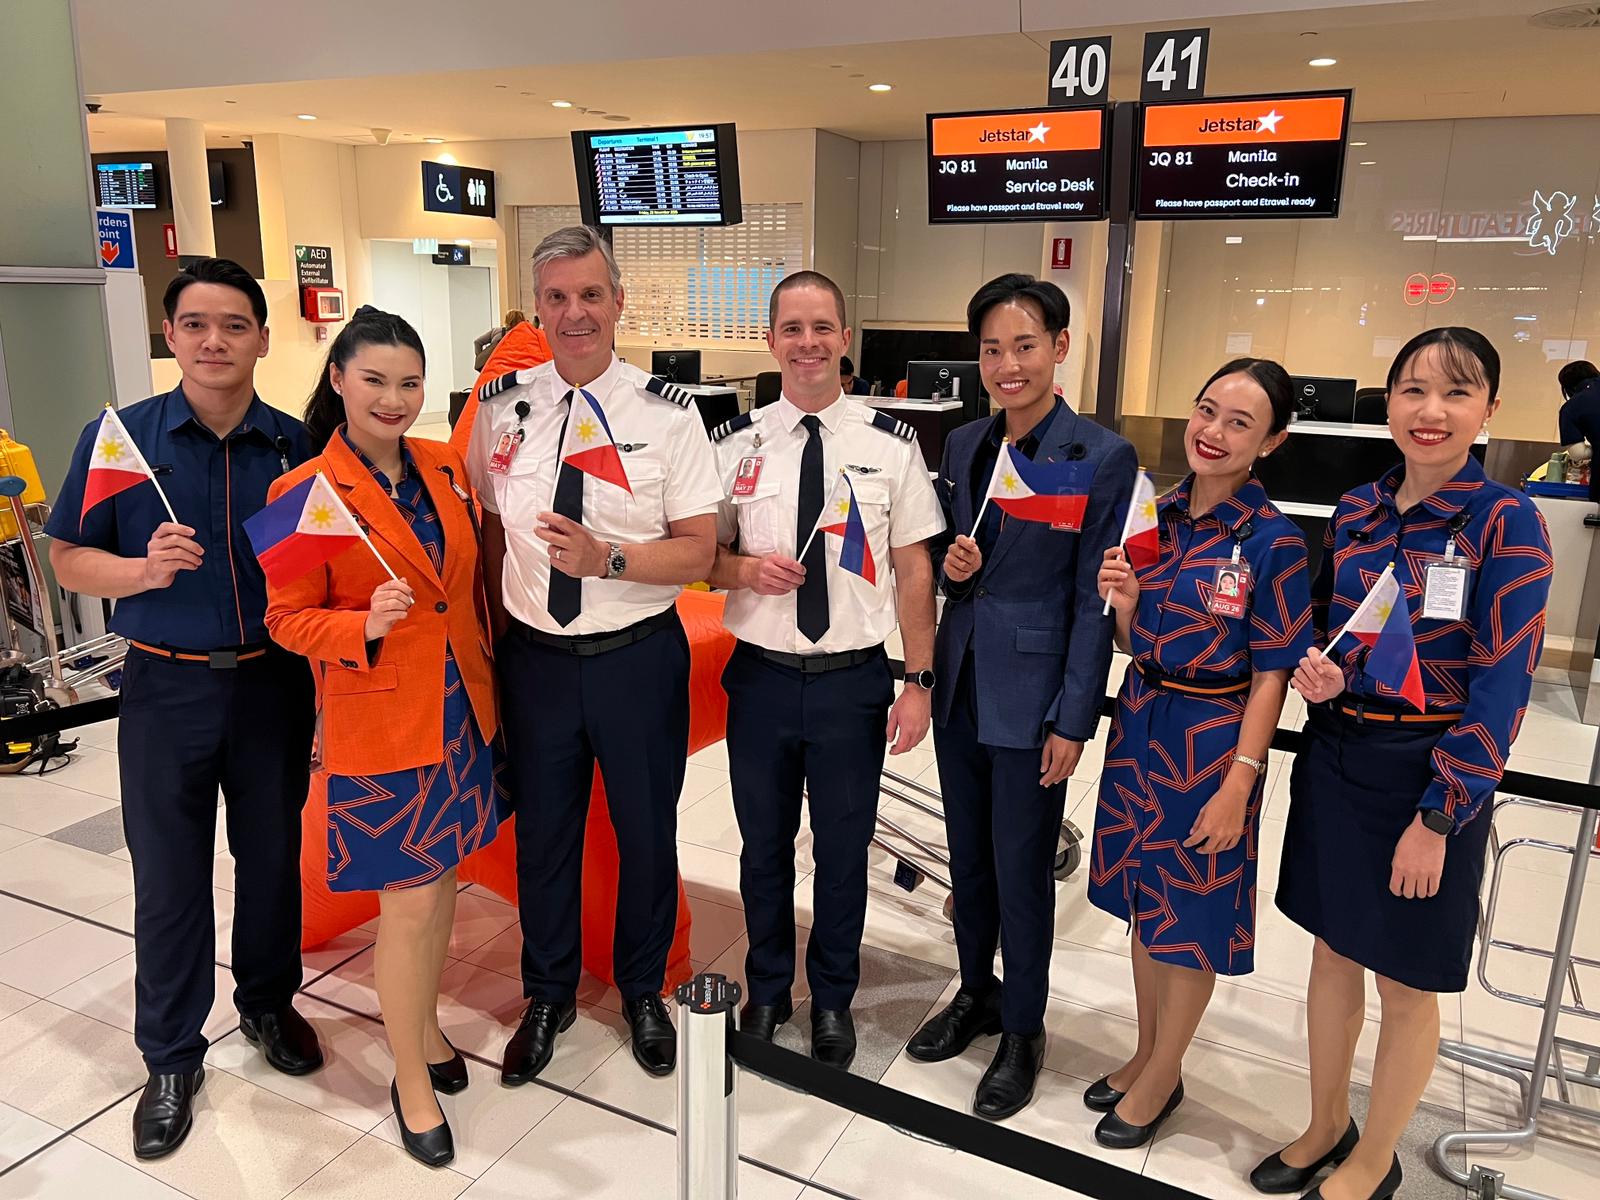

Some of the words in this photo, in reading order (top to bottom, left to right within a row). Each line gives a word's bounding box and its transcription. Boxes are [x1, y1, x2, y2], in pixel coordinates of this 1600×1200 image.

[1051, 44, 1107, 97] 40
[1147, 36, 1202, 91] 41
[1199, 117, 1260, 133] Jetstar
[979, 128, 1031, 143] Jetstar
[1149, 152, 1171, 167] JQ
[1175, 151, 1193, 165] 81
[1228, 149, 1277, 163] Manila
[938, 160, 958, 174] JQ
[960, 159, 977, 173] 81
[1006, 157, 1048, 171] Manila
[1005, 179, 1057, 194] Service
[1060, 177, 1095, 192] Desk
[1226, 172, 1300, 188] Check-in
[946, 204, 970, 212] Please
[970, 204, 987, 212] have
[988, 203, 1020, 213] passport
[1021, 202, 1036, 211] and
[1036, 201, 1062, 210] Etravel
[1062, 201, 1084, 211] ready
[1155, 199, 1182, 208] Please
[1183, 199, 1202, 207] have
[1204, 198, 1241, 208] passport
[1241, 197, 1259, 206] and
[1259, 196, 1290, 206] Etravel
[1291, 196, 1316, 207] ready
[98, 216, 128, 228] rdens
[99, 228, 120, 239] oint
[310, 248, 327, 260] AED
[300, 262, 327, 270] Automated
[1213, 602, 1230, 611] AUG
